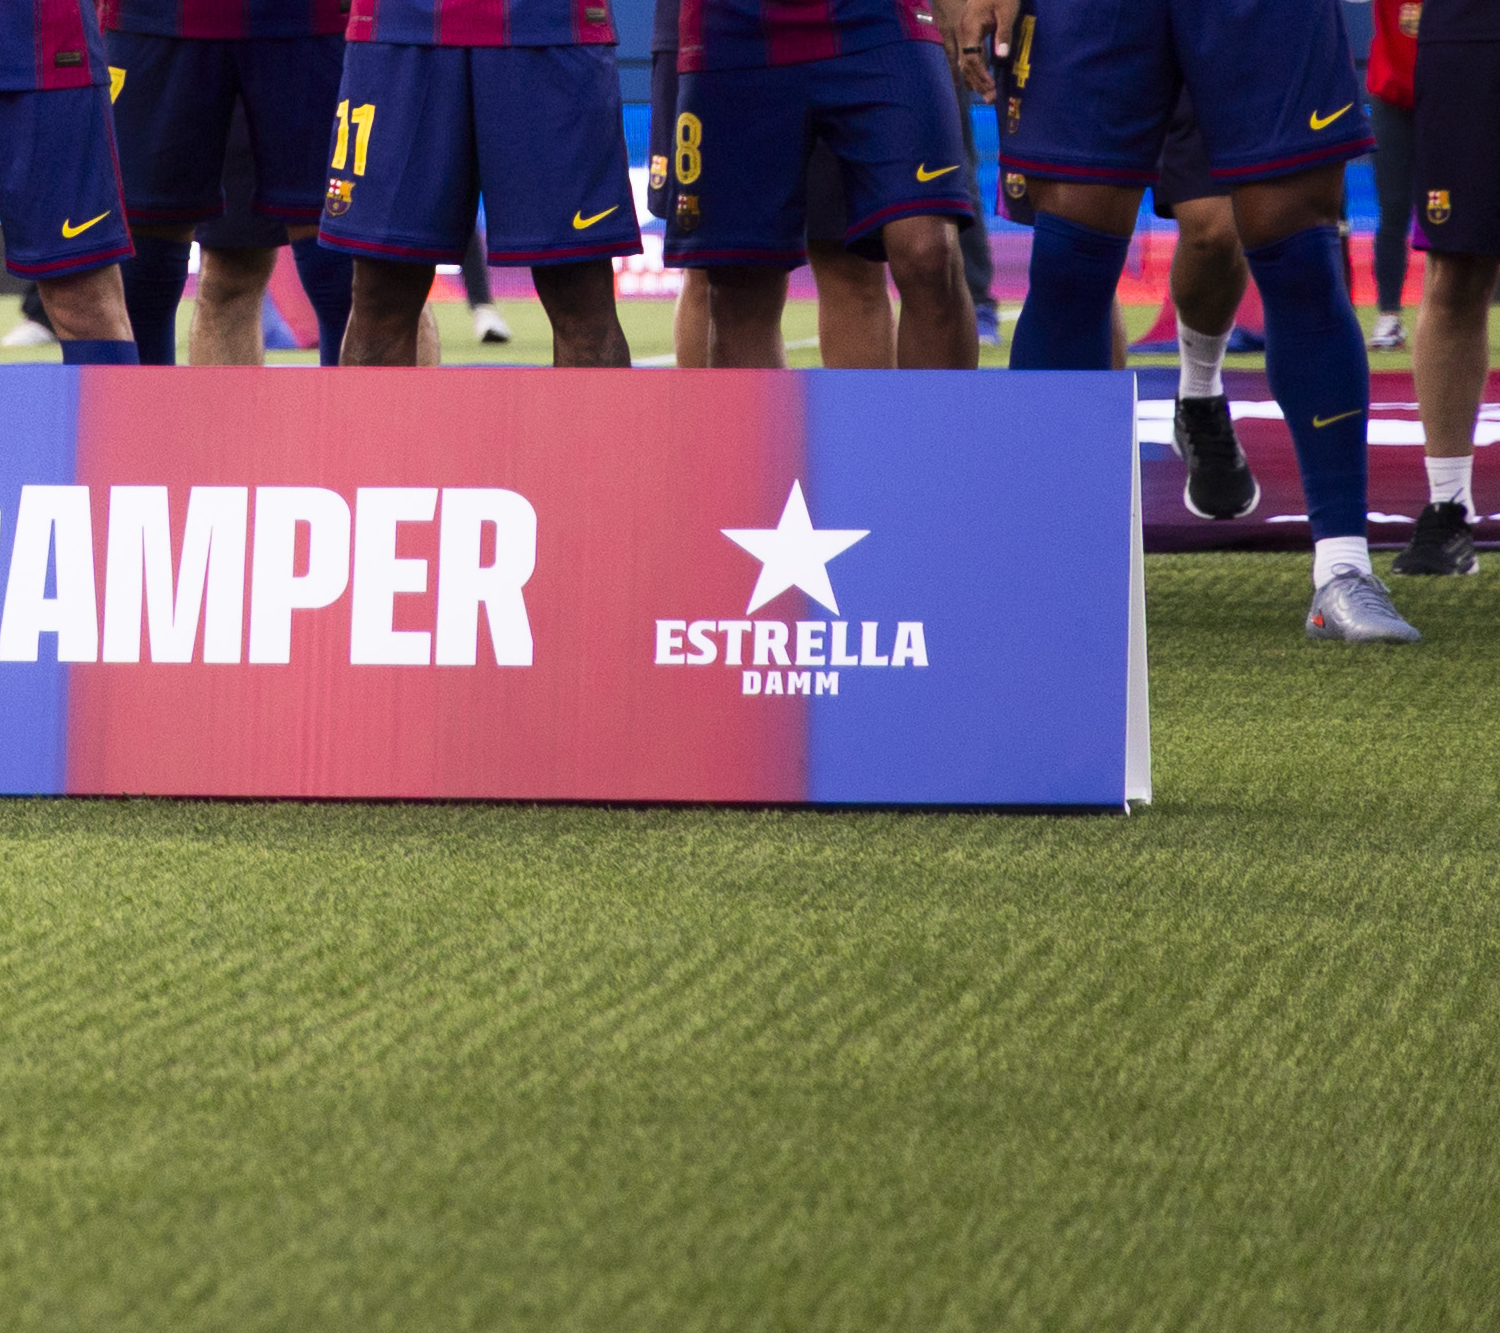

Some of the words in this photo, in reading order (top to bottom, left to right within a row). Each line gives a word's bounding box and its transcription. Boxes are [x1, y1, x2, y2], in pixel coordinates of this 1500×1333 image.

[331, 99, 376, 177] 11
[675, 111, 702, 185] 8
[655, 620, 930, 666] ESTRELLA
[742, 671, 840, 695] DAMM
